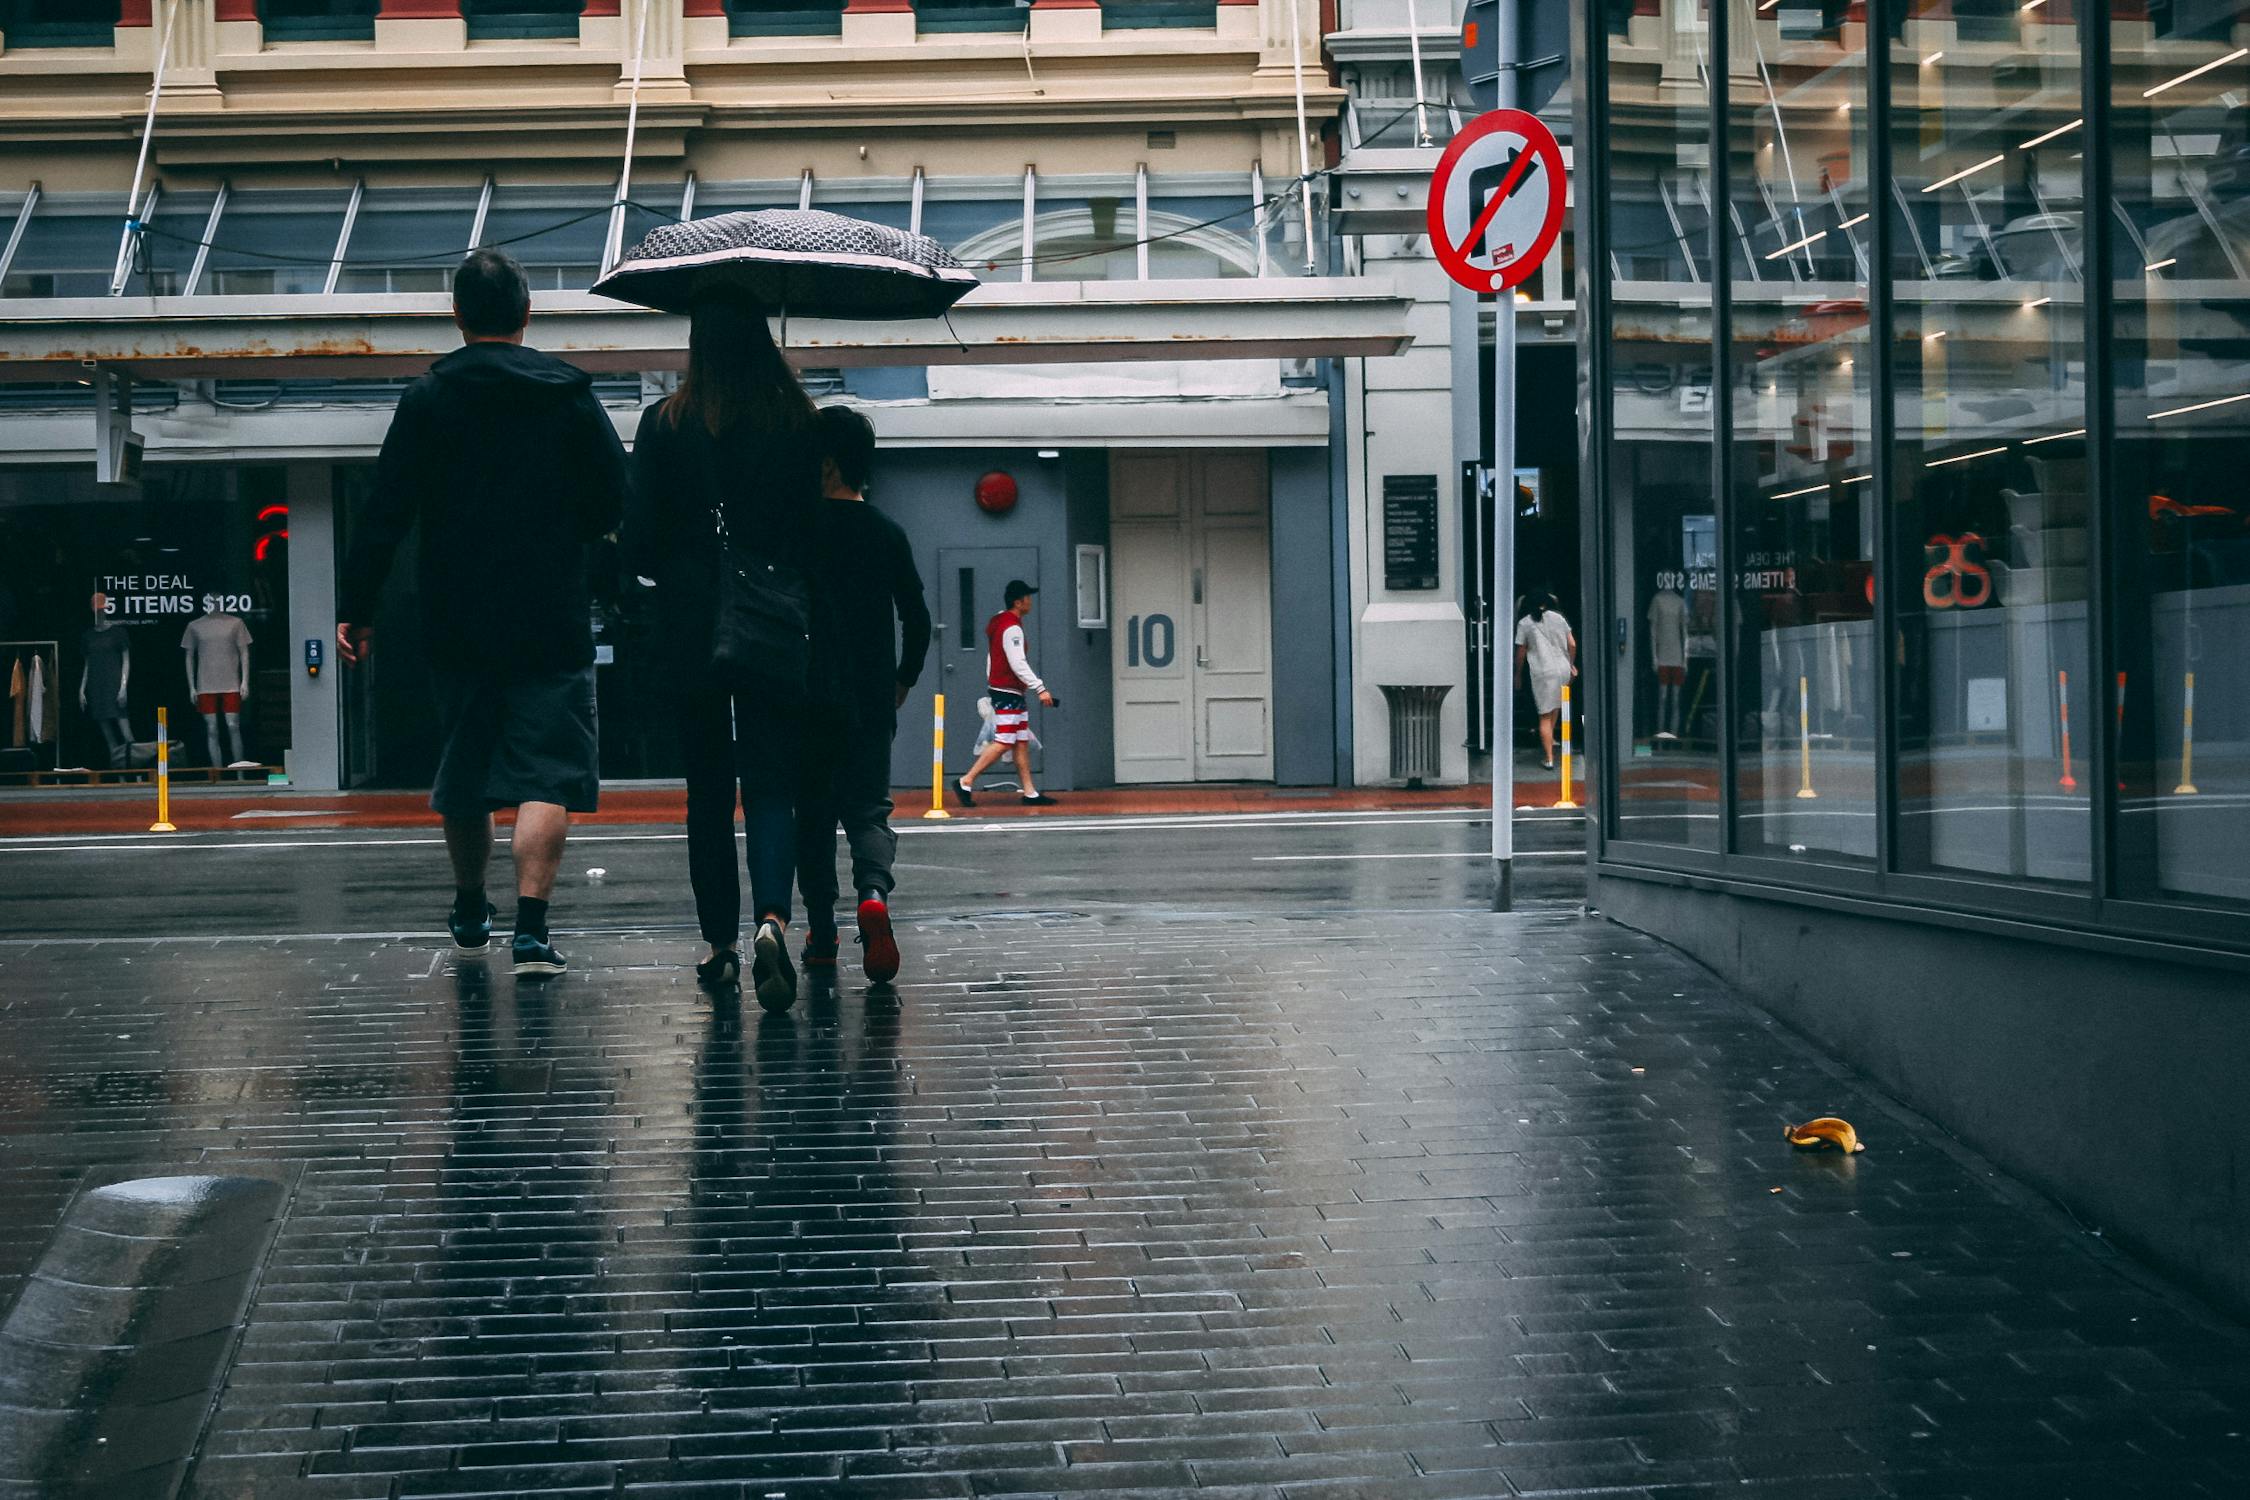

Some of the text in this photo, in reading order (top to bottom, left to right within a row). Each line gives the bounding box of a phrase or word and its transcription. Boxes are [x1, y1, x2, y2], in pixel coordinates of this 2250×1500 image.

[103, 574, 194, 590] THE DEAL
[103, 593, 252, 614] 5 ITEMS $120
[1127, 613, 1175, 668] 10
